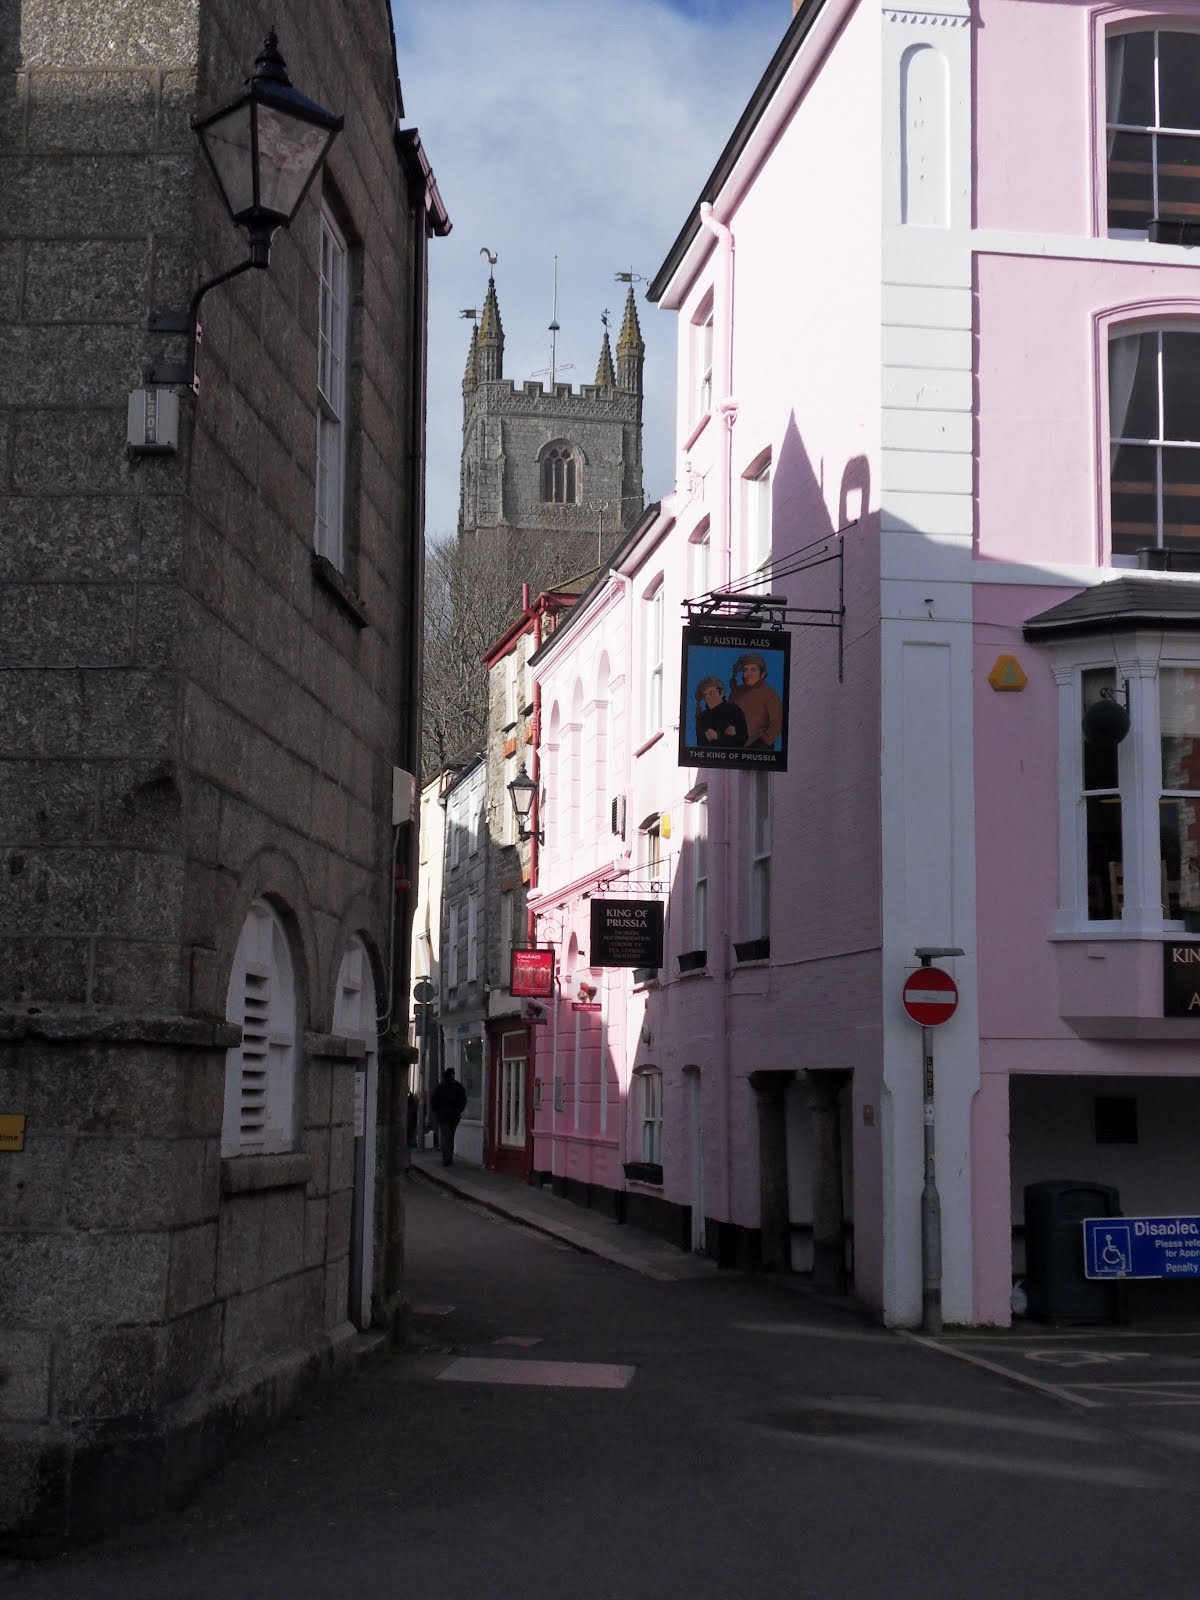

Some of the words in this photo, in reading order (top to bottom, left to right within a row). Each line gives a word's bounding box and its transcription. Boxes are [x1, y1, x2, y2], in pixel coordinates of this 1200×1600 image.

[147, 392, 155, 440] L201
[713, 636, 748, 646] AUSTELL
[750, 638, 771, 647] ALES
[689, 750, 705, 758] THE
[706, 751, 726, 760] KING
[728, 752, 740, 760] OF
[741, 753, 777, 762] PRUSSIA
[606, 908, 632, 918] KING
[634, 909, 648, 918] OF
[606, 918, 648, 928] PRUSSIA
[1172, 947, 1200, 963] KIN
[1155, 1239, 1183, 1248] Please
[1165, 1249, 1178, 1257] for
[1165, 1262, 1199, 1274] Penalty
